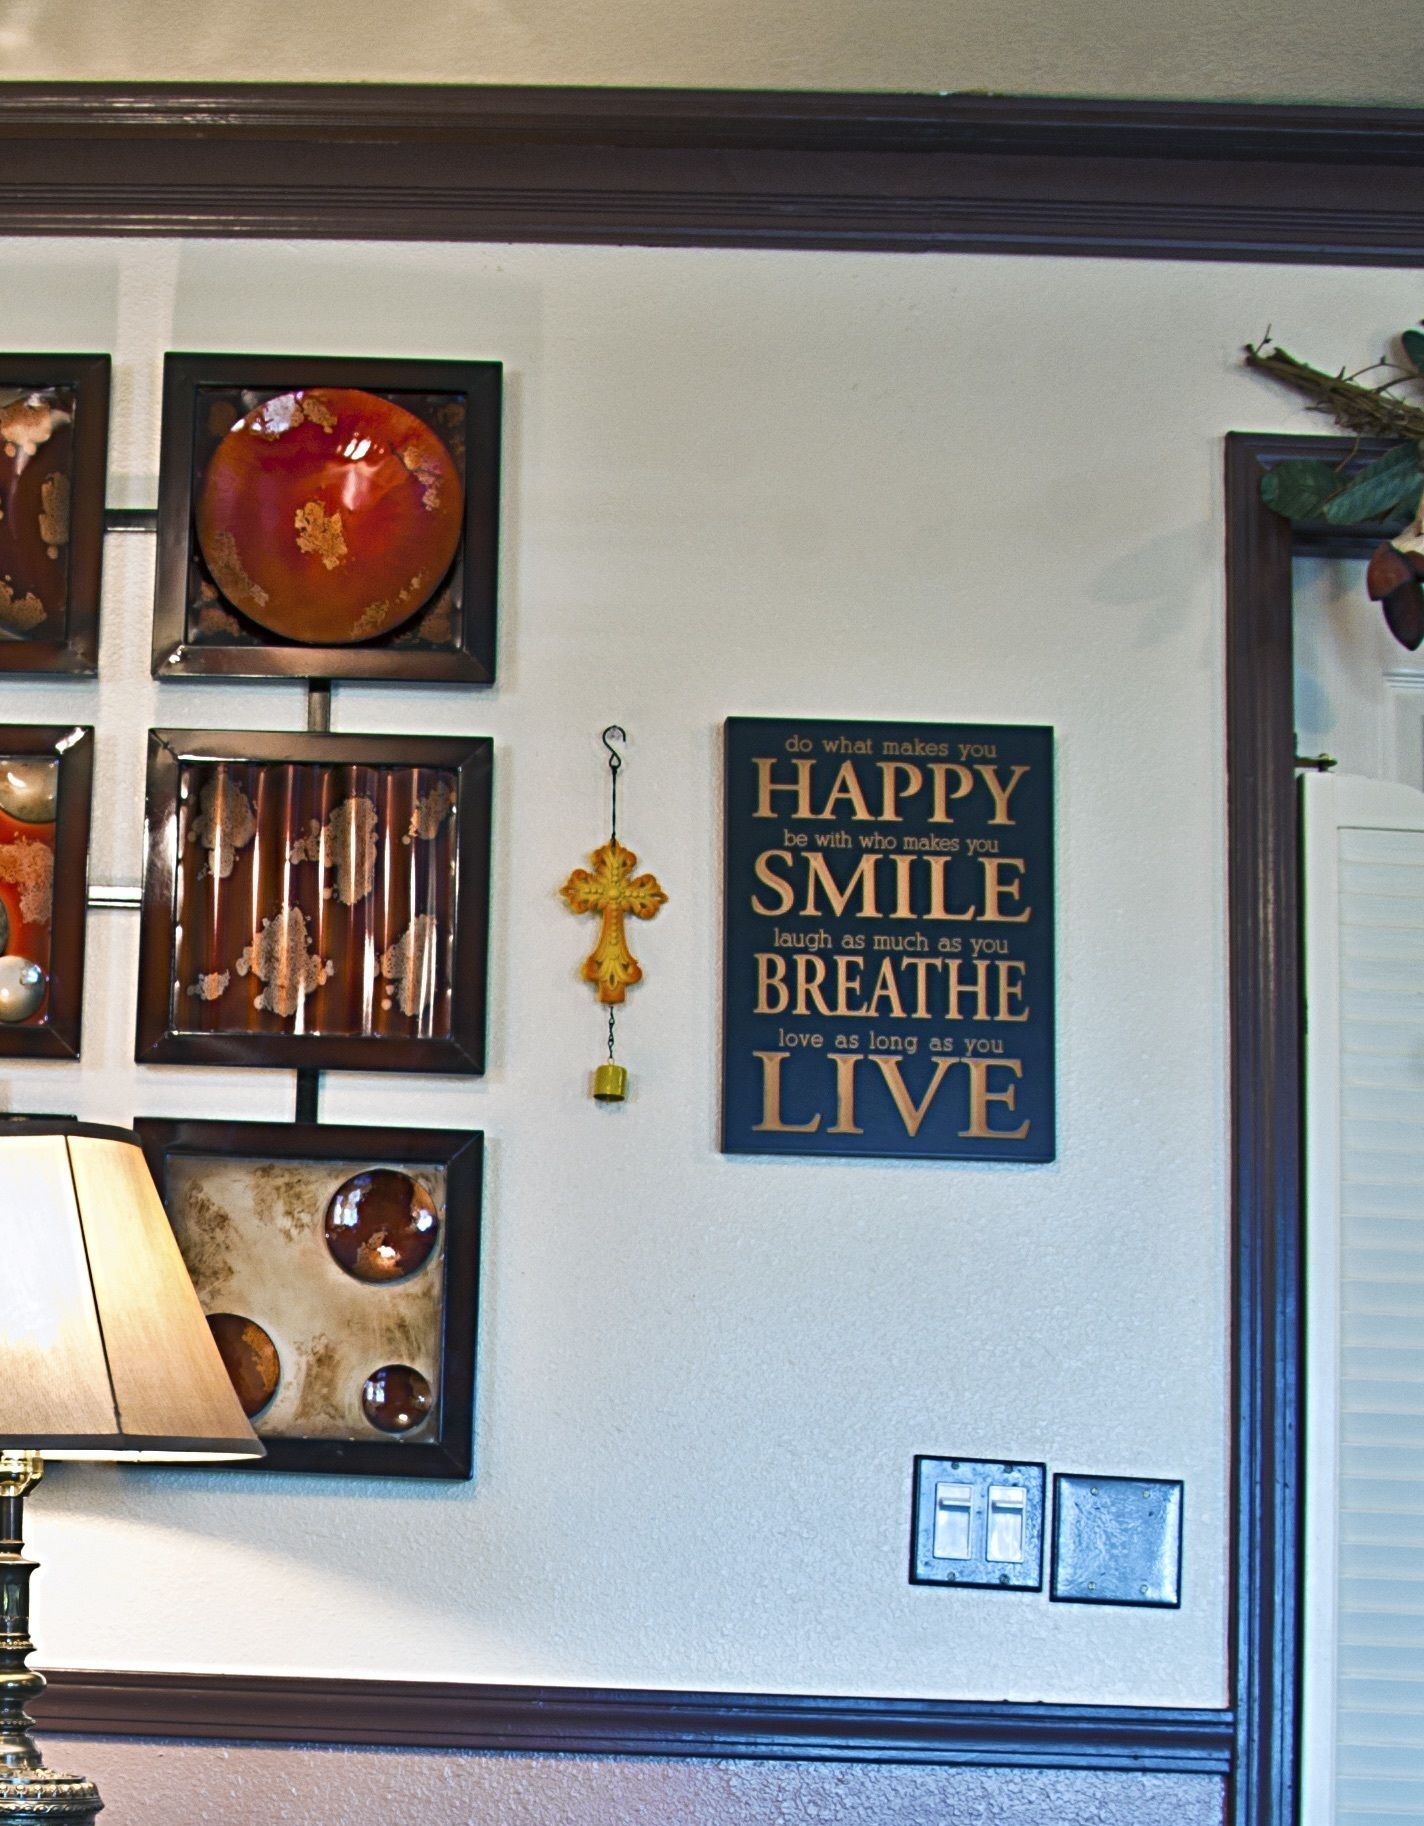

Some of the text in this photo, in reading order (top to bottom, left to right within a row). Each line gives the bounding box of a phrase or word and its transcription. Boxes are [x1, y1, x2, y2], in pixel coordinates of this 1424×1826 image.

[785, 735, 997, 760] do what makes you
[751, 757, 1031, 825] HAPPY
[784, 829, 1000, 856] be with who makes you
[751, 849, 1031, 923] SMILE
[774, 928, 1009, 958] laugh as much as you
[753, 952, 1030, 1022] BREATHE
[778, 1028, 1005, 1057] love as long as you
[751, 1050, 1032, 1140] LIVE
